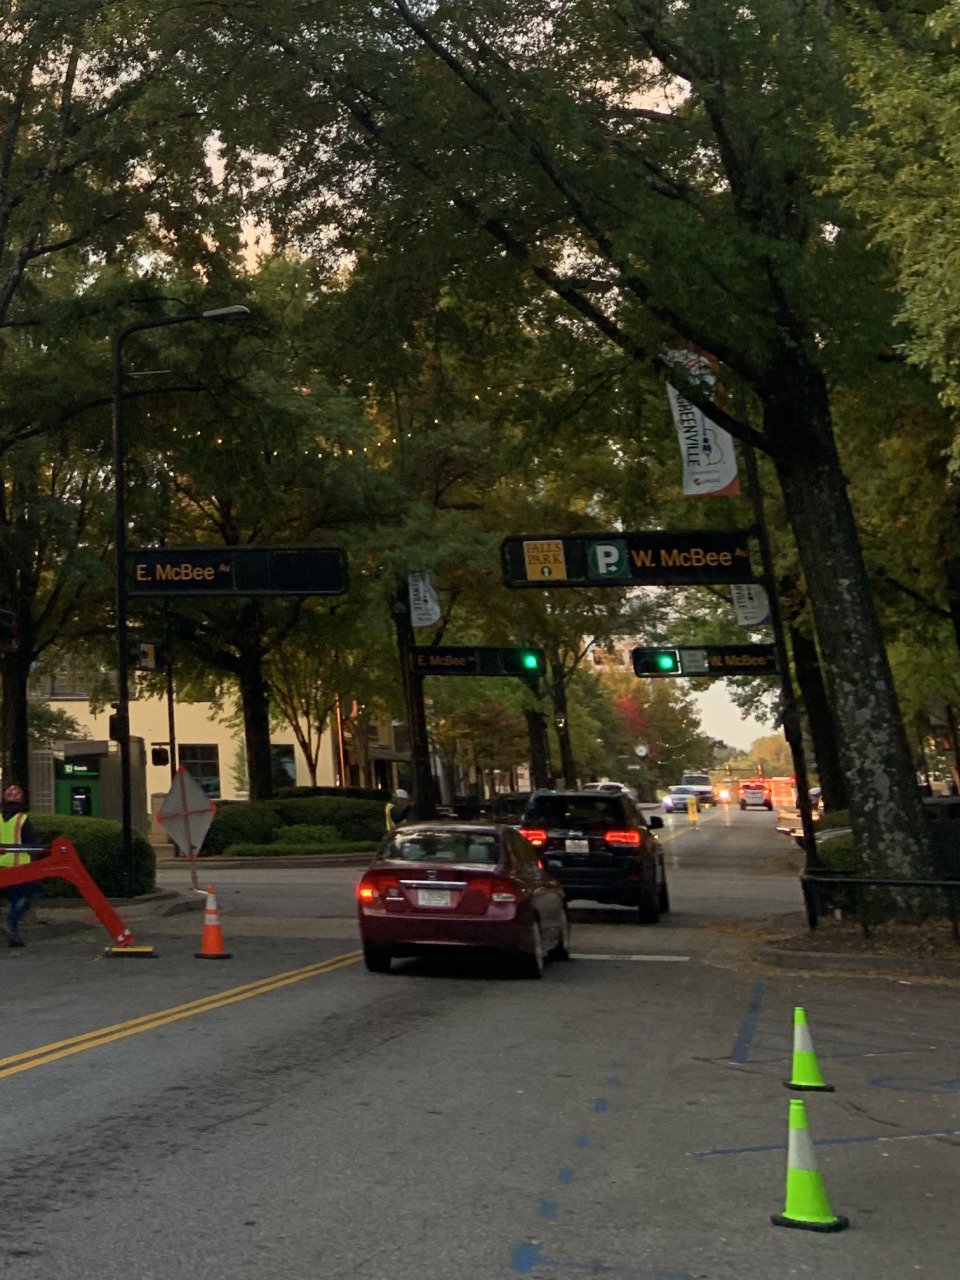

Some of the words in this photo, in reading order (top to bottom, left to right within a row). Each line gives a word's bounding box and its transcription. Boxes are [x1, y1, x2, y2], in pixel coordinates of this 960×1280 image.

[527, 543, 561, 554] FALLS
[528, 554, 563, 565] PARK
[631, 549, 656, 568] W.
[659, 548, 733, 568] McBee
[136, 564, 152, 581] E.
[155, 563, 215, 581] McBee
